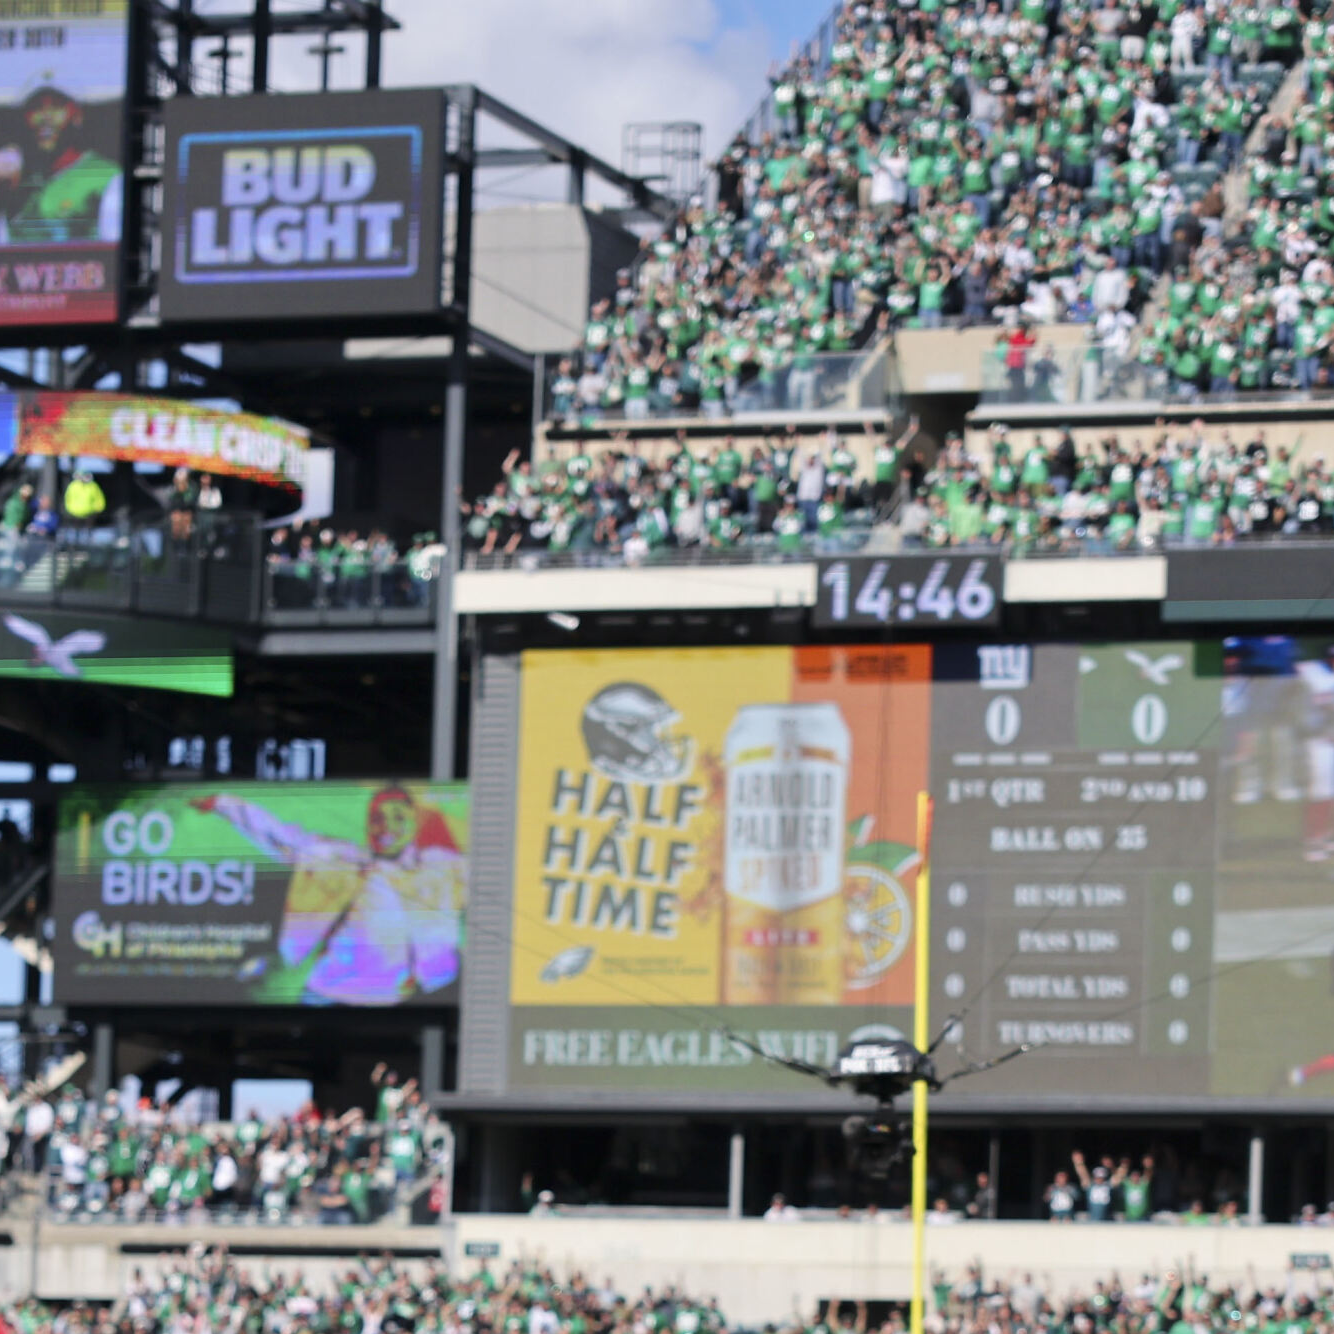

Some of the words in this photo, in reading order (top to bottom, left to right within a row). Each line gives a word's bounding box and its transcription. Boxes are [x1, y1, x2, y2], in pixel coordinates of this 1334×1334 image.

[222, 144, 376, 207] BUD
[190, 202, 405, 264] LIGHT
[110, 405, 215, 457] CLEAN
[822, 559, 995, 621] 14:46
[985, 694, 1021, 746] 0
[1132, 693, 1167, 745] 0
[552, 768, 706, 831] HALF
[736, 772, 833, 810] ARNOLD
[991, 777, 1045, 808] QTR
[102, 811, 175, 856] GO
[543, 826, 698, 885] HALF
[733, 815, 832, 852] PALMER
[991, 826, 1060, 851] BALL
[1064, 826, 1104, 850] ON
[101, 859, 256, 906] BIRDS!
[541, 875, 680, 939] TIME
[523, 1028, 614, 1067] FREE
[617, 1027, 754, 1067] EAGLES
[997, 1020, 1134, 1045] TURNOVERS
